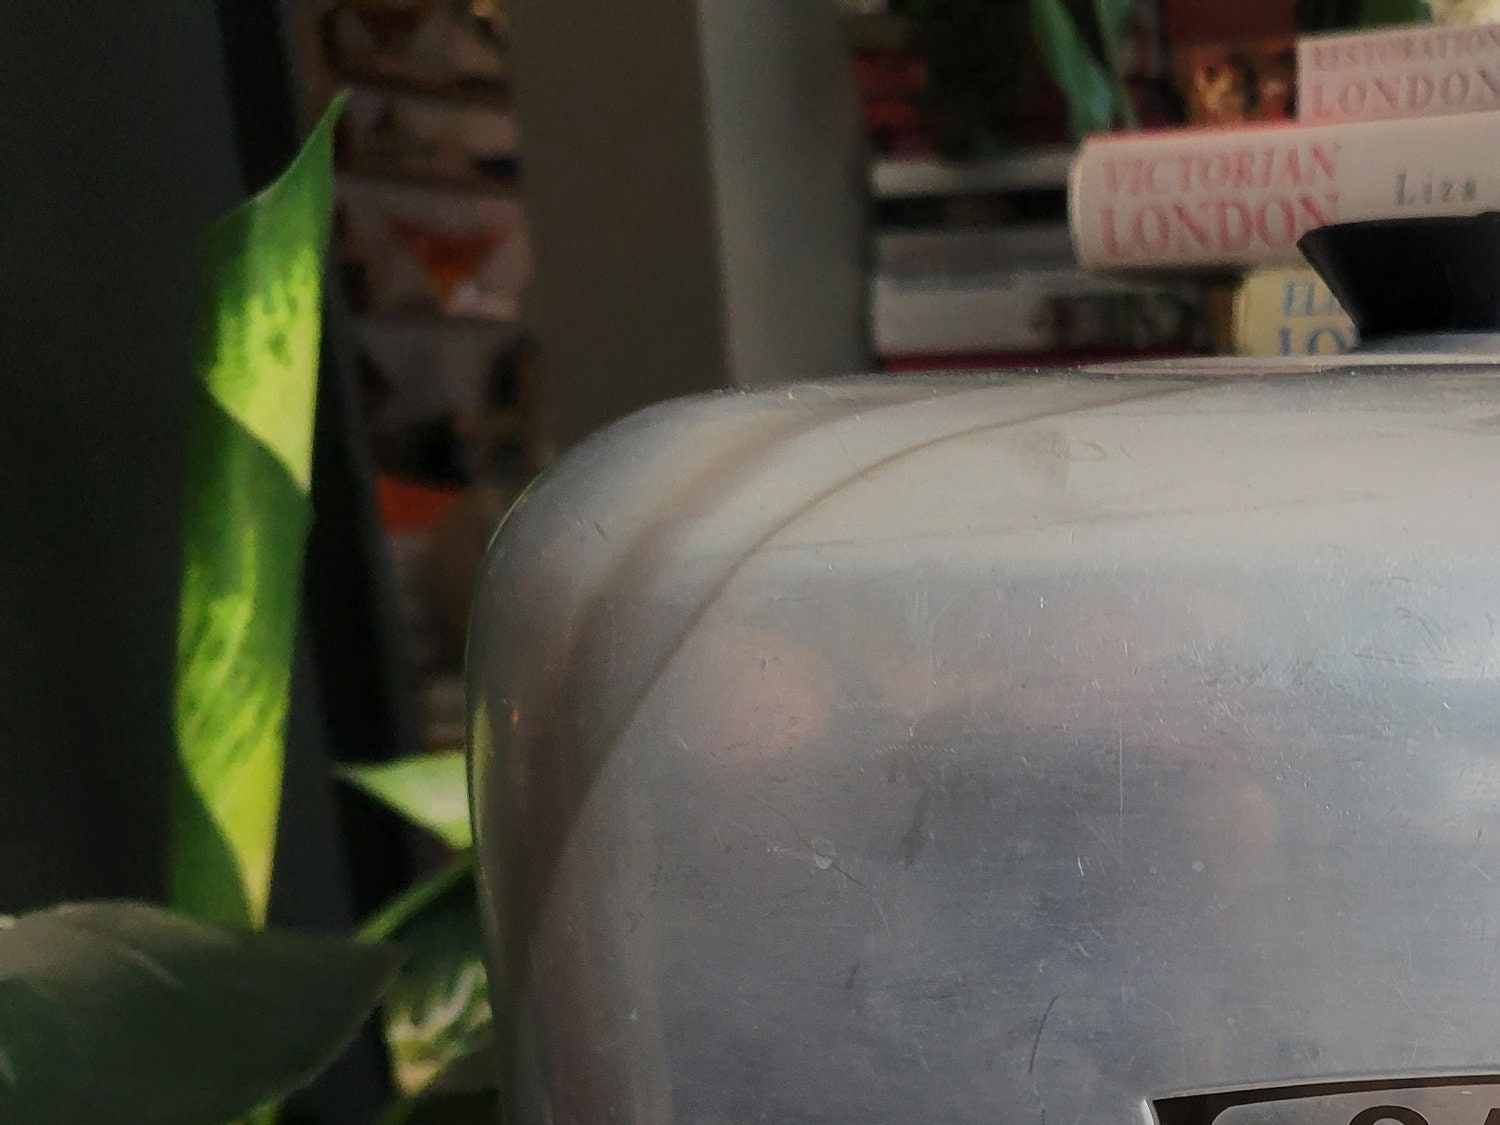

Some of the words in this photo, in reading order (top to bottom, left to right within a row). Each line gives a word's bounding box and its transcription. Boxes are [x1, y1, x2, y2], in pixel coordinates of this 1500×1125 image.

[1103, 143, 1342, 196] VICTORIAN
[1395, 170, 1477, 205] Liza
[1103, 193, 1342, 260] LONDON
